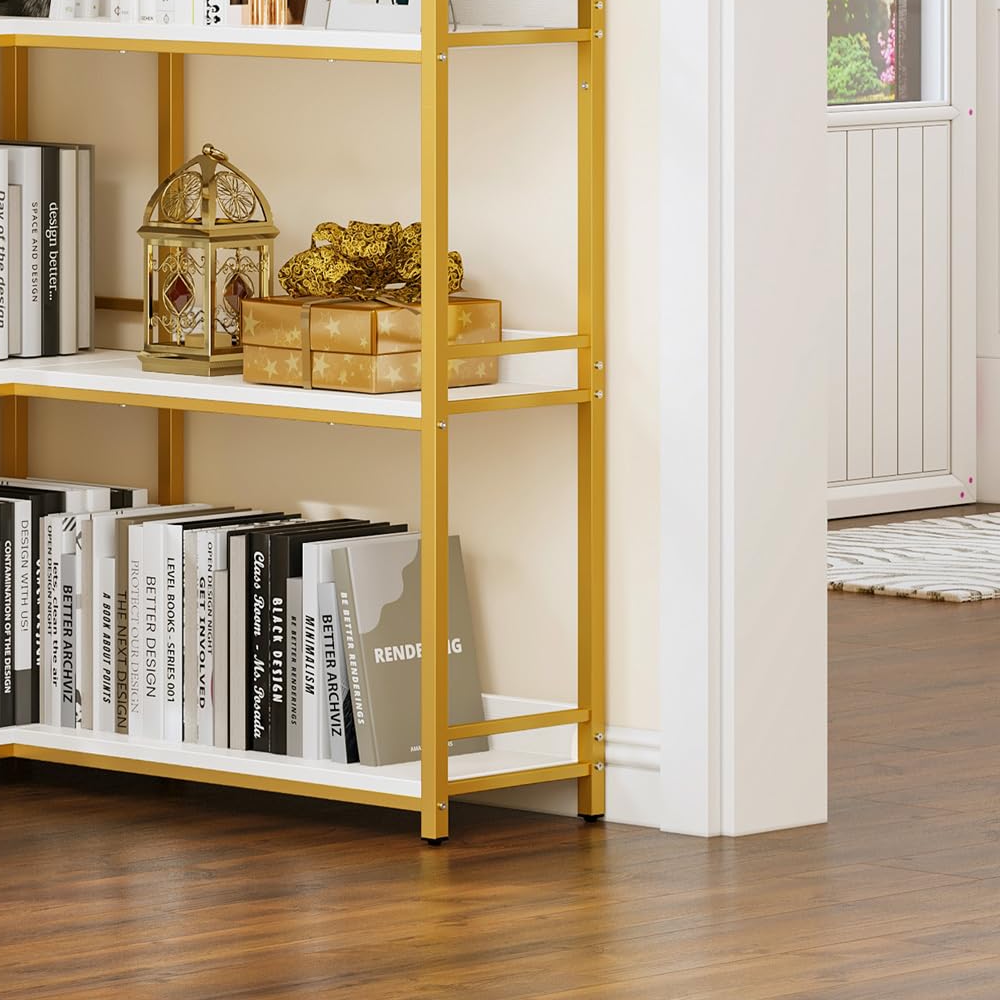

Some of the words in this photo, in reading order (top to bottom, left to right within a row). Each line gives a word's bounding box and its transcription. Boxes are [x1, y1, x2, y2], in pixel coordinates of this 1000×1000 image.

[46, 202, 58, 247] design
[49, 250, 58, 301] better...
[21, 520, 29, 568] DESIGN
[4, 540, 12, 620] CONTAMINATION
[21, 573, 29, 606] WITH
[168, 557, 176, 589] LEVEL
[254, 551, 265, 590] Class
[63, 585, 73, 637] BETTER
[102, 592, 111, 600] A
[117, 591, 127, 619] THE
[131, 560, 140, 625] PROTECT
[146, 576, 156, 632] BETTER
[340, 592, 348, 606] BE
[4, 623, 12, 636] OF
[21, 611, 29, 632] US!
[102, 603, 111, 630] BOOK
[168, 594, 176, 632] BOOKS
[254, 594, 265, 637] Room
[272, 597, 284, 642] BLACK
[291, 616, 297, 626] BE
[343, 610, 354, 649] BETTER
[4, 636, 12, 656] THE
[102, 633, 111, 666] ABOUT
[117, 626, 127, 666] NEXT
[131, 627, 140, 658] OUR
[305, 615, 315, 696] MINIMALISM
[322, 614, 336, 668] BETTER
[374, 638, 462, 664] RENDEG
[4, 658, 12, 694] DESIGN
[63, 640, 73, 704] ARCHVIZ
[146, 638, 156, 698] DESIGN
[168, 642, 176, 680] SERIES
[254, 654, 265, 682] Ms.
[272, 650, 284, 703] DESIGN
[102, 668, 111, 704] POINTS
[117, 671, 127, 728] DESIGN
[131, 662, 140, 714] DESIGN
[168, 683, 176, 702] 001
[327, 672, 342, 736] ARCHVIZ
[349, 654, 365, 725] RENDERINGS
[254, 685, 265, 740] Posada
